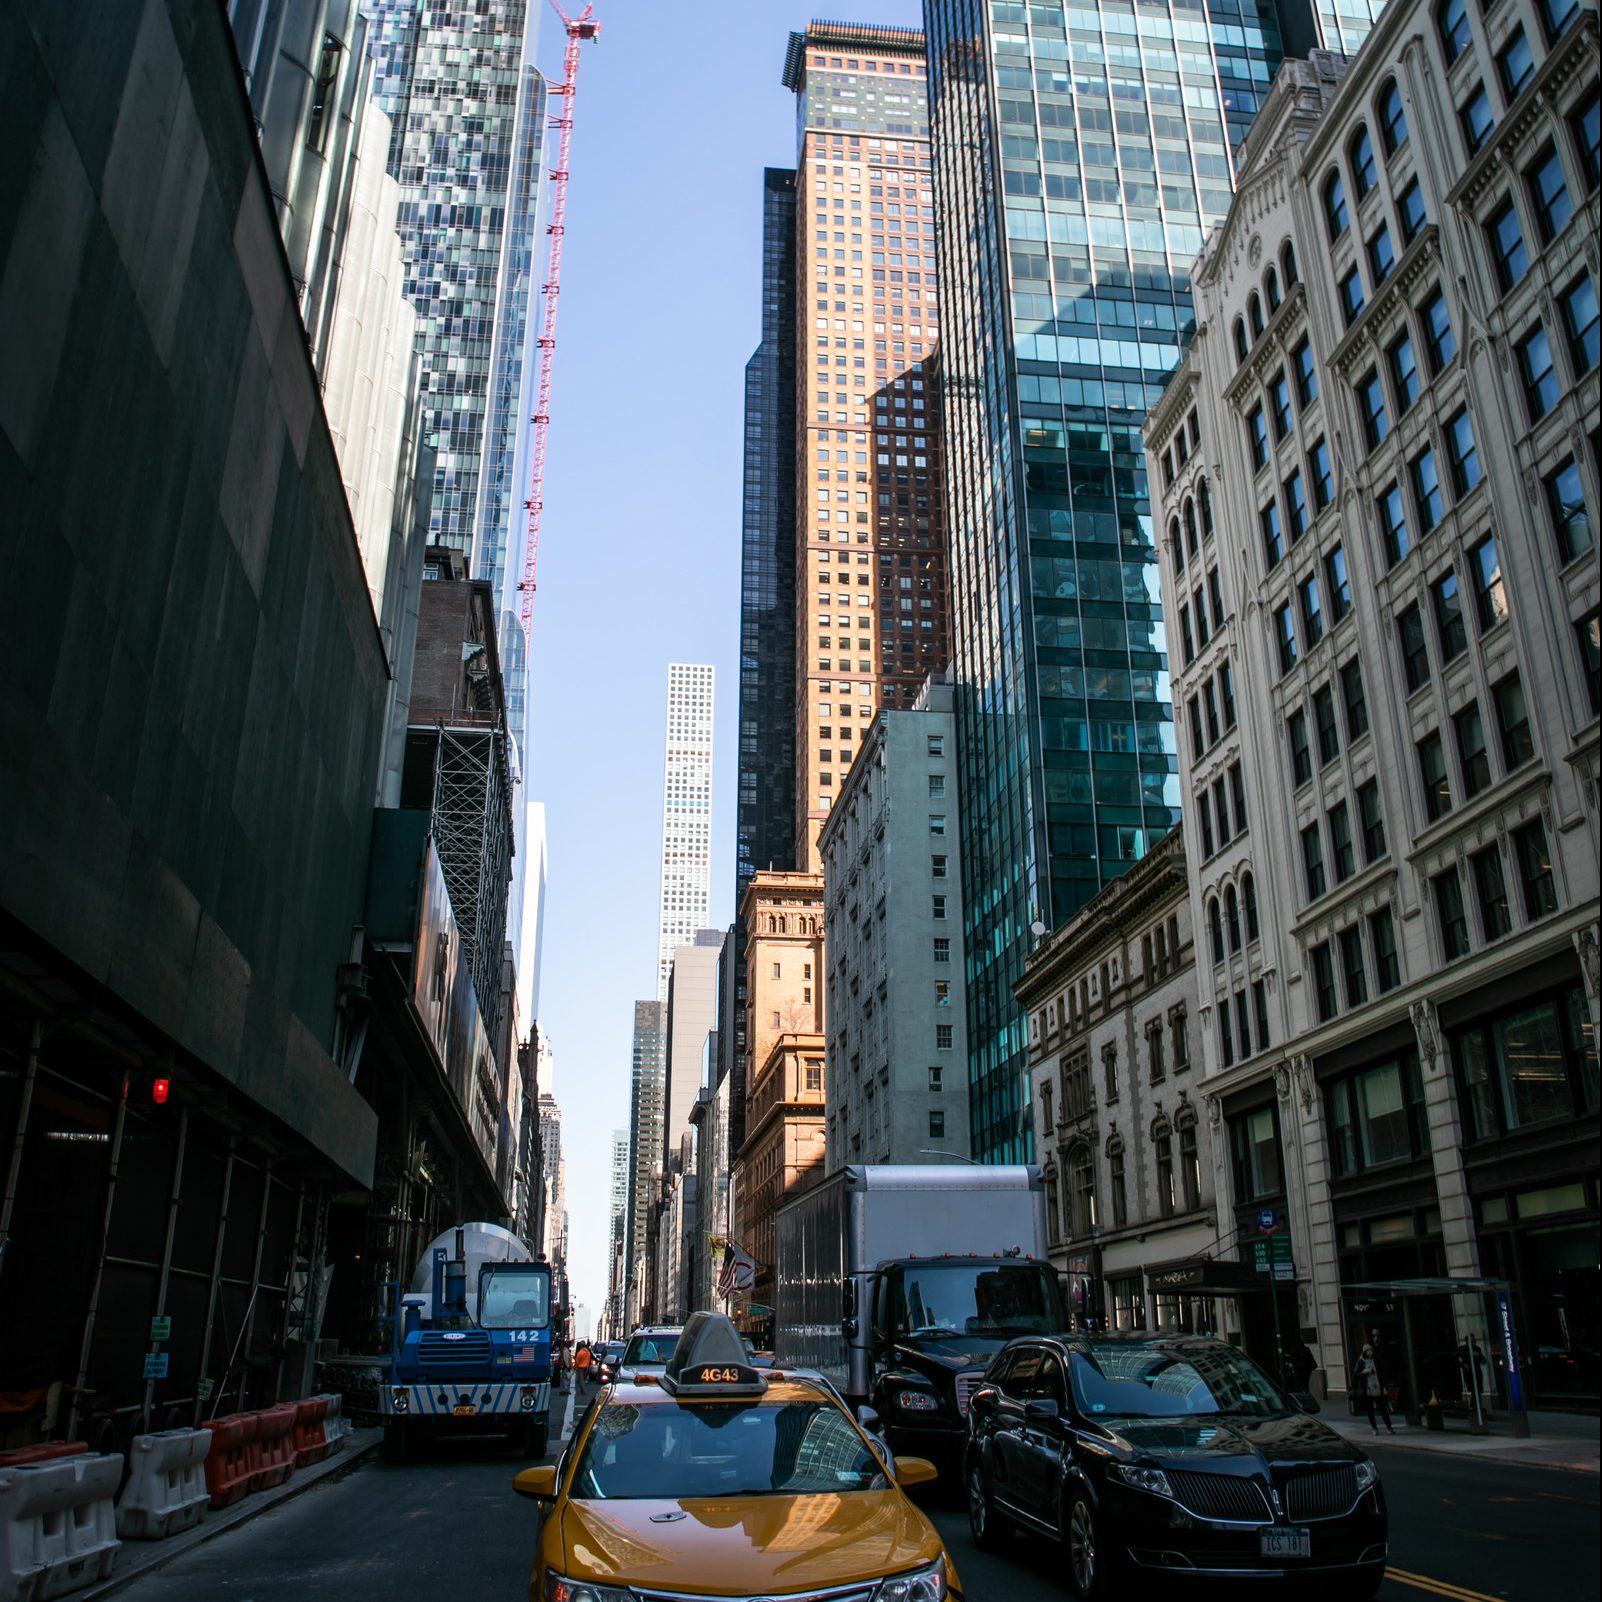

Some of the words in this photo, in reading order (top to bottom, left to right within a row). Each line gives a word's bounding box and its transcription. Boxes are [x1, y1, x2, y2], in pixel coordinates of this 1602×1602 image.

[509, 1330, 539, 1342] 142
[700, 1368, 739, 1382] 4G43
[1288, 1537, 1301, 1551] 181
